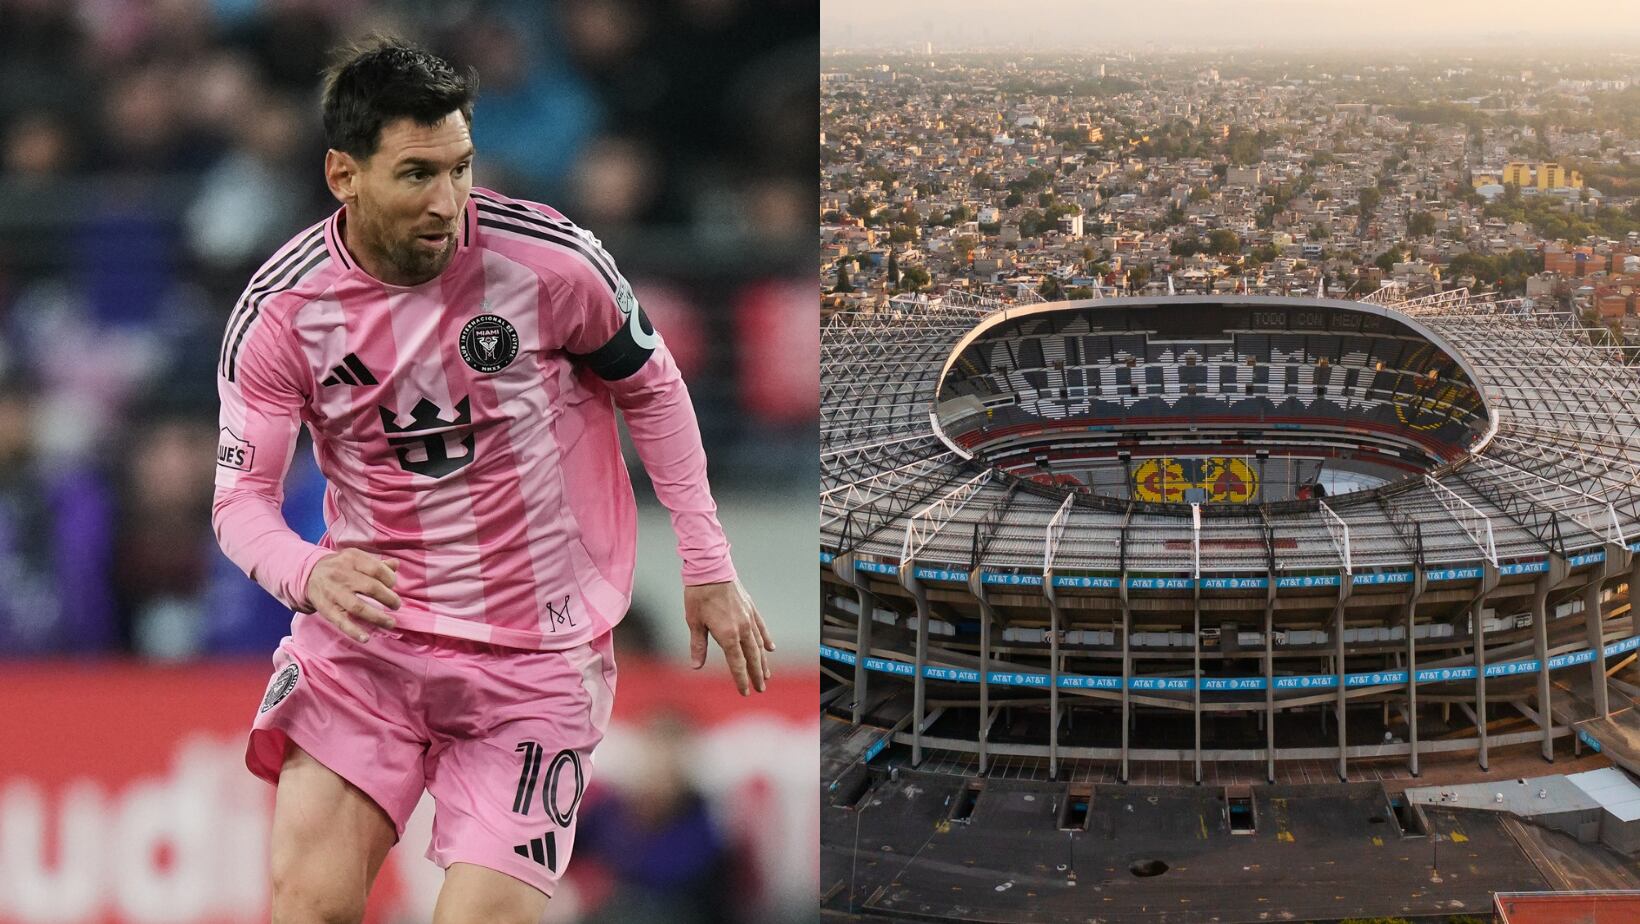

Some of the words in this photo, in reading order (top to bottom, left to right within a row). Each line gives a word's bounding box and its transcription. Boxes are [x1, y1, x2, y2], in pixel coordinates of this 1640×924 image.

[461, 316, 505, 343] INTERNACIONAL
[461, 345, 471, 362] CLUB
[1585, 554, 1602, 564] AT&T
[859, 562, 876, 570] AT&T
[888, 566, 897, 575] AT
[1457, 569, 1477, 578] AT&T
[1502, 566, 1512, 574] &T
[1524, 564, 1544, 572] AT&T
[918, 569, 937, 579] AT&T
[1353, 575, 1374, 584] AT&T
[1387, 574, 1408, 582] AT&T
[988, 575, 1008, 583] AT&T
[1022, 577, 1042, 585] AT&T
[1059, 578, 1079, 586] AT&T
[1093, 578, 1114, 587] AT&T
[1132, 579, 1153, 587] AT&T
[1167, 579, 1188, 588] AT&T
[1205, 579, 1226, 588] AT&T
[1240, 580, 1261, 588] AT&T
[1280, 578, 1301, 586] AT&T
[1315, 577, 1336, 585] AT&T
[1605, 646, 1617, 655] AT&T
[1626, 638, 1640, 648] AT&T
[841, 653, 856, 664] AT&T
[1575, 652, 1592, 662] AT&T
[867, 660, 884, 669] AT&T
[896, 664, 913, 673] AT&T
[1486, 666, 1506, 675] AT&T
[1518, 662, 1538, 671] AT&T
[928, 668, 946, 677] AT&T
[959, 671, 978, 680] AT&T
[992, 674, 1012, 683] AT&T
[1025, 676, 1045, 684] AT&T
[1350, 676, 1370, 684] AT&T
[1383, 673, 1403, 682] AT&T
[1419, 671, 1439, 679] AT&T
[1452, 669, 1472, 678] AT&T
[1063, 678, 1083, 686] AT&T
[1134, 680, 1154, 688] AT&T
[1168, 680, 1189, 688] AT&T
[1240, 680, 1260, 688] AT&T
[1278, 678, 1298, 687] AT&T
[1312, 677, 1332, 685] AT&T
[512, 740, 584, 828] 10
